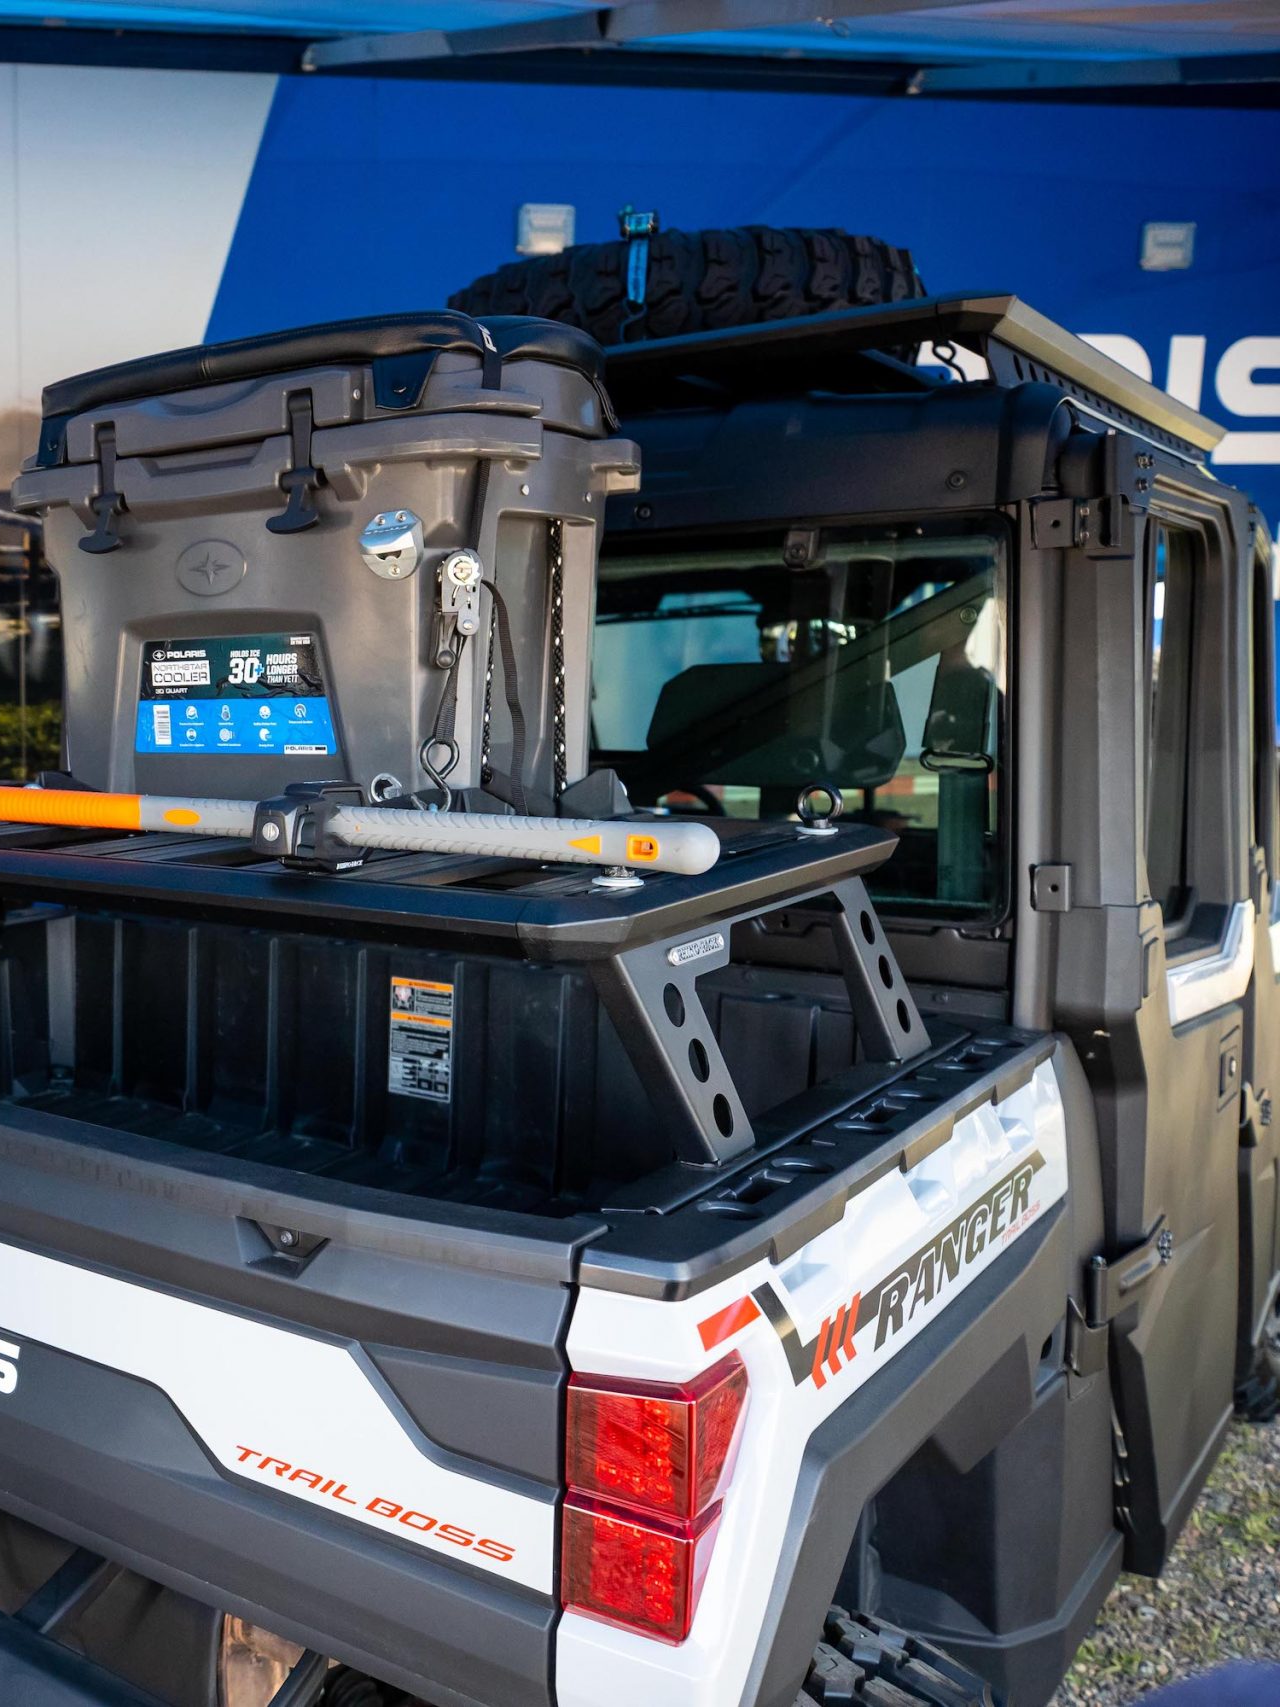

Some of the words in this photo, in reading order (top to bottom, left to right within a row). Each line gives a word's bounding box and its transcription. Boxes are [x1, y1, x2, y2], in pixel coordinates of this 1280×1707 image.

[167, 650, 206, 659] POLARIS
[230, 650, 249, 658] HOLDS
[250, 649, 260, 657] ICE
[266, 653, 298, 665] HOURS
[154, 663, 208, 671] NORTHSTAR
[266, 664, 299, 675] LONGER
[154, 672, 208, 683] COOLER
[267, 675, 283, 684] THAN
[874, 1164, 1033, 1353] RANGER
[236, 1445, 357, 1505] TRAIL
[365, 1497, 516, 1562] BOSS
